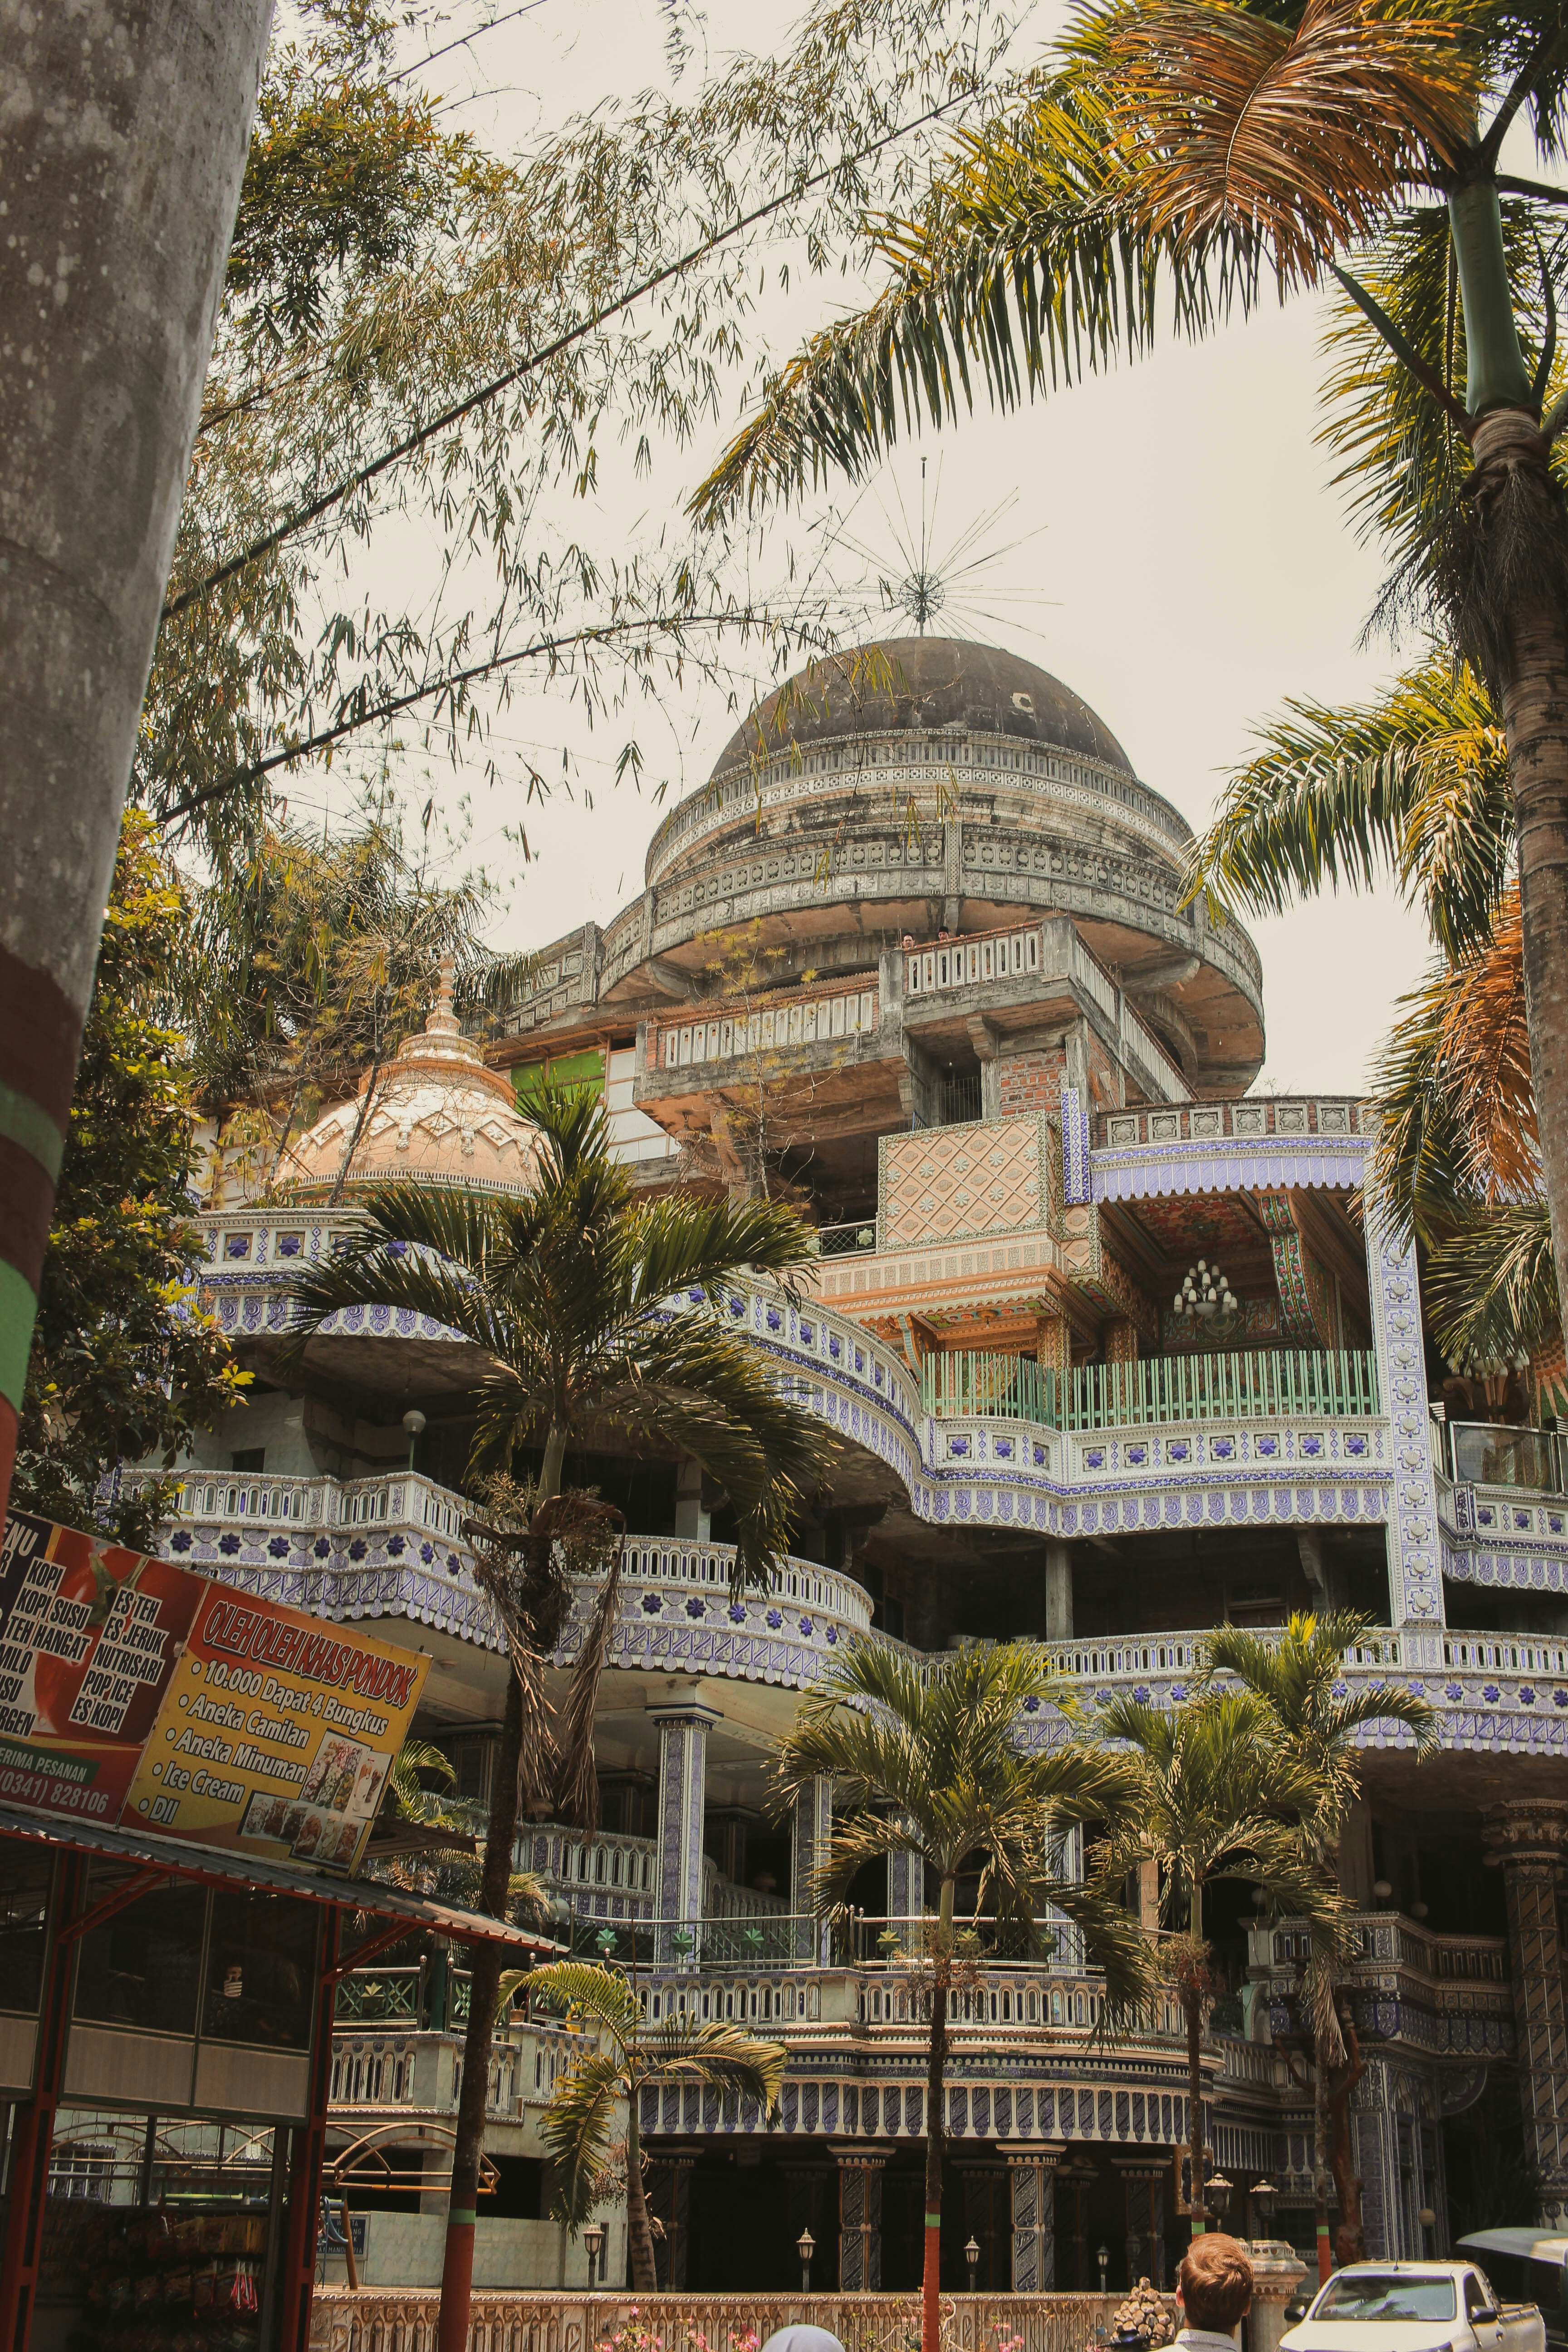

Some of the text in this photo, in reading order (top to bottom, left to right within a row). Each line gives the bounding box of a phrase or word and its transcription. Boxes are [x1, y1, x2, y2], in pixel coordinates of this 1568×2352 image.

[4, 1516, 39, 1557] NU
[26, 1559, 64, 1592] KOPI
[15, 1587, 90, 1631] KOPI SUSU
[113, 1590, 160, 1623] ES TEH
[6, 1615, 90, 1660] TEH HANGAT
[103, 1616, 166, 1655] ES JERUK
[203, 1600, 418, 1709] OLEH OLEH KHAS PONDOK
[92, 1643, 163, 1683] NUTRISARI
[81, 1669, 135, 1704] POP ICE
[204, 1659, 389, 1736] 10.000 Dapat 4 Bungkus
[0, 1705, 36, 1737] RGEN
[71, 1696, 125, 1731] ES KOPI
[186, 1693, 310, 1749] Aneka Camilan
[34, 1757, 88, 1783] PESANAN
[173, 1727, 308, 1784] Aneka Minuman
[0, 1770, 109, 1813] (0341) 828106
[162, 1760, 245, 1804] Ice Cream
[149, 1795, 181, 1825] Dll
